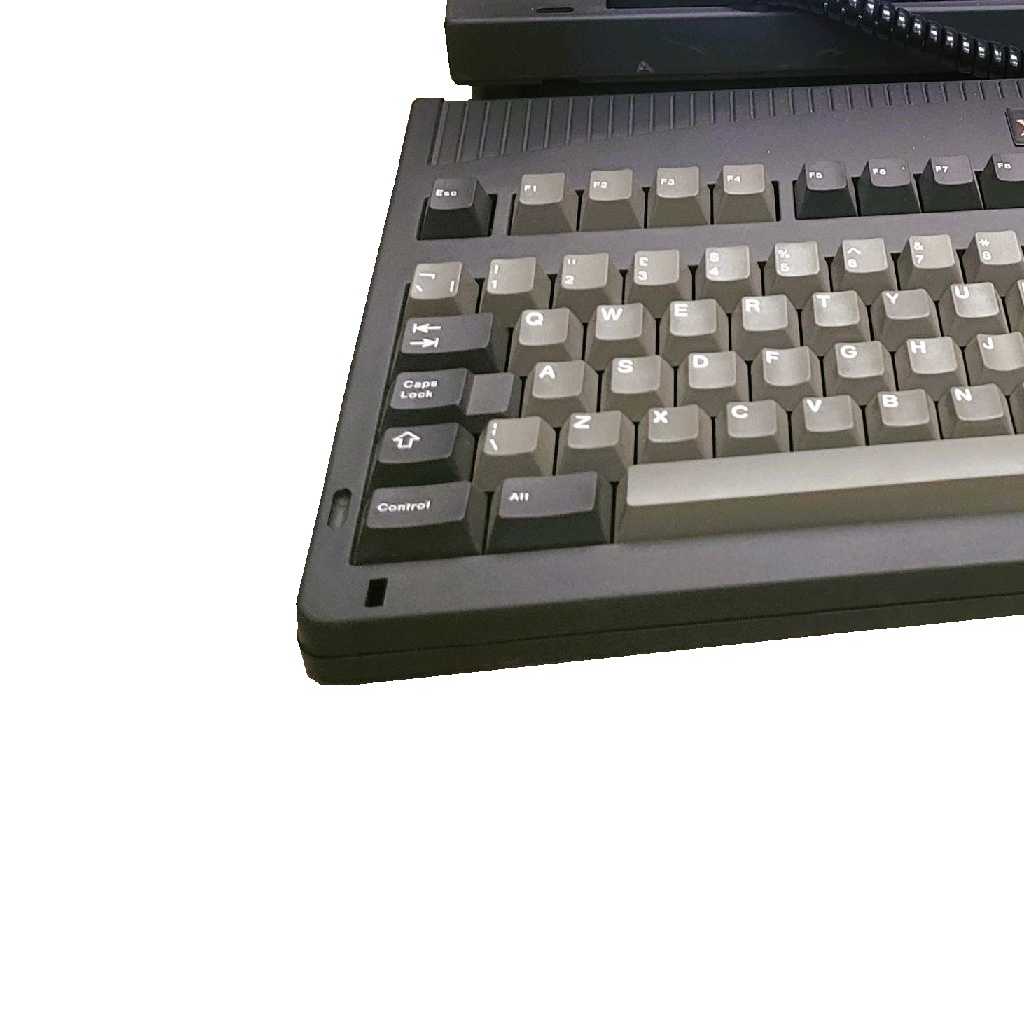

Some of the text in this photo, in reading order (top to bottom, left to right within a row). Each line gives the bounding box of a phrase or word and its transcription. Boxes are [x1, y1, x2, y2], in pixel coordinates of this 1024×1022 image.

[727, 175, 741, 183] F4
[809, 171, 822, 179] F5
[436, 189, 457, 197] Esc
[524, 184, 536, 192] F1
[912, 242, 924, 251] &
[915, 254, 924, 264] 7
[981, 250, 992, 260] 8
[780, 263, 790, 272] 5
[848, 258, 858, 268] 6
[638, 270, 648, 281] 3
[709, 268, 720, 276] 4
[564, 276, 574, 284] 2
[885, 292, 899, 304] Y
[954, 285, 970, 300] U
[746, 299, 761, 312] R
[816, 294, 831, 308] T
[601, 308, 623, 321] W
[674, 303, 688, 317] E
[525, 312, 544, 326] Q
[910, 340, 927, 354] H
[982, 337, 994, 350] J
[765, 350, 780, 364] F
[840, 344, 858, 359] G
[617, 360, 634, 374] S
[693, 354, 709, 368] D
[538, 365, 556, 380] A
[404, 380, 438, 390] Caps
[400, 390, 433, 399] Lock
[882, 394, 899, 408] B
[954, 388, 972, 402] N
[730, 404, 748, 419] C
[806, 400, 822, 413] V
[574, 416, 592, 429] Z
[653, 410, 668, 424] X
[509, 492, 530, 502] Alt
[377, 500, 431, 512] Control
